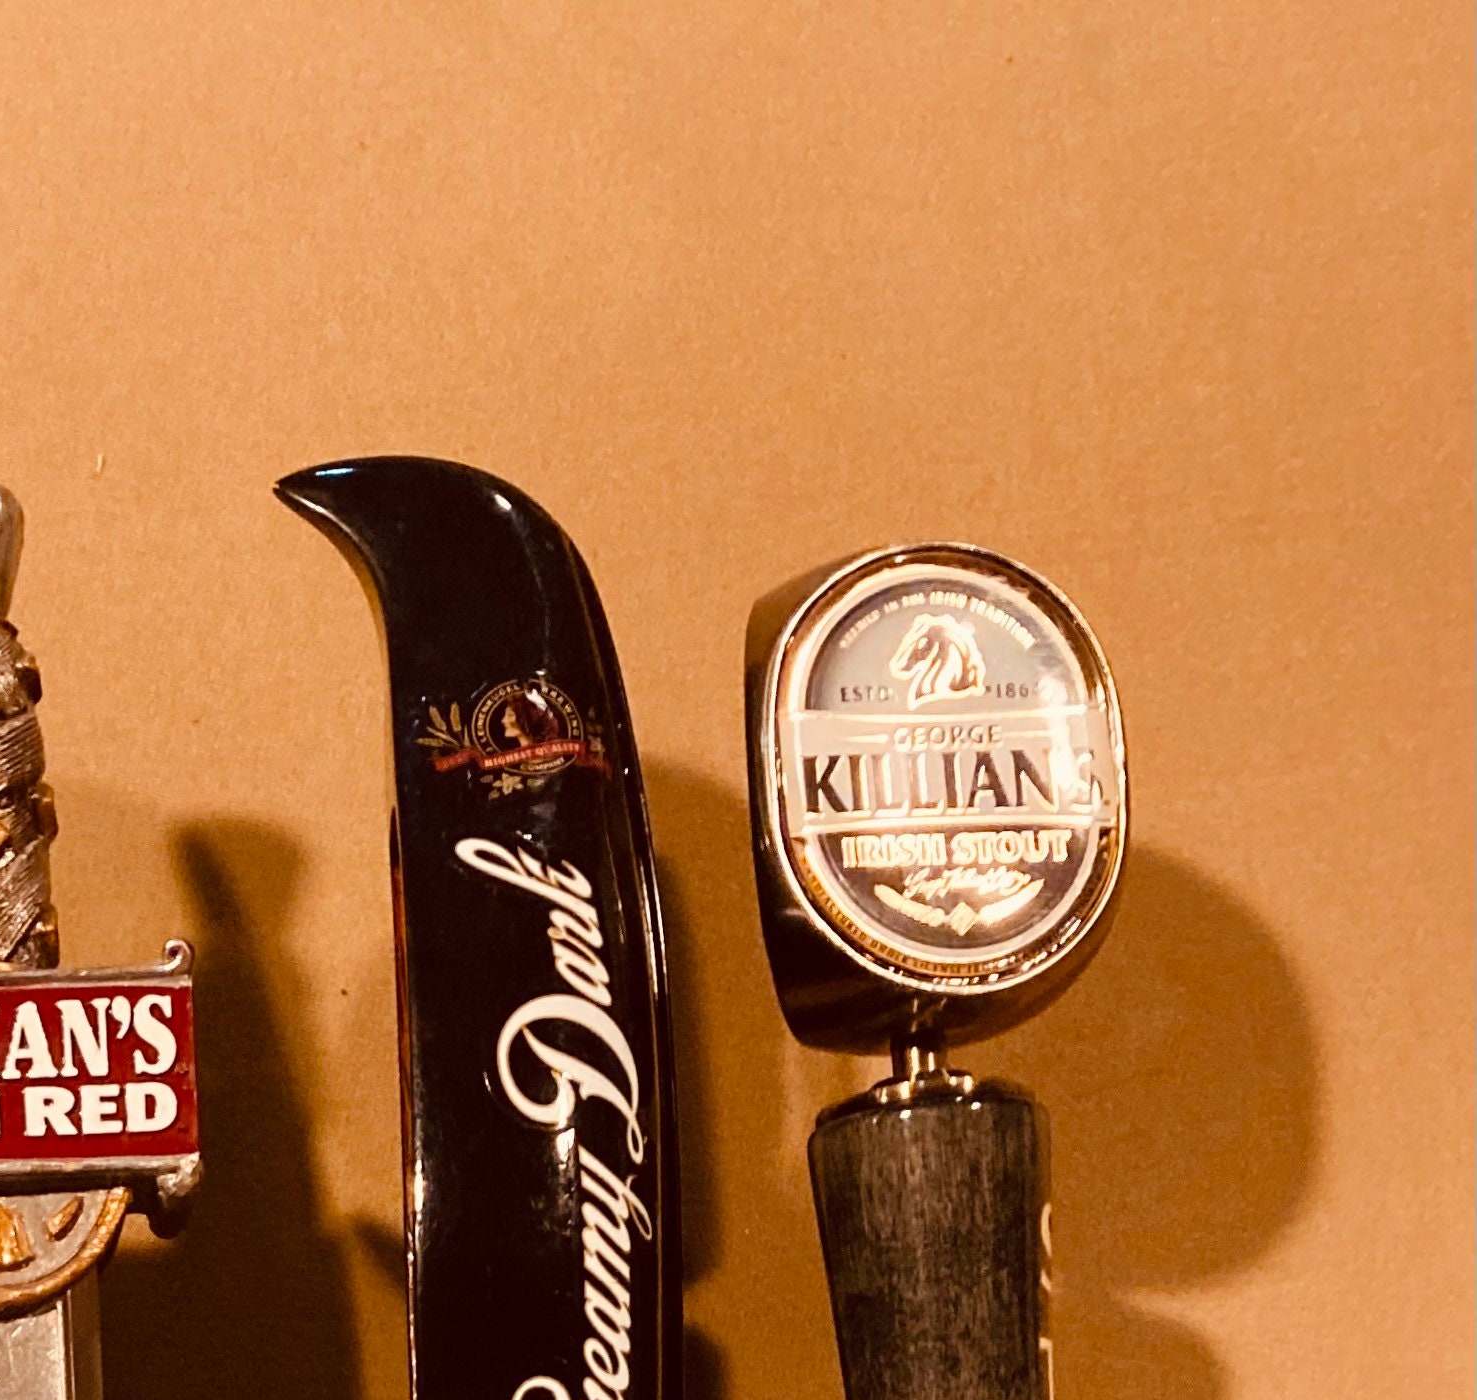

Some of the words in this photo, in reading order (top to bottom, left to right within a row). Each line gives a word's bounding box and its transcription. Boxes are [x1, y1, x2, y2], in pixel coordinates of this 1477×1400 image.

[893, 725, 1003, 750] GEORGE
[841, 832, 947, 868] IRISH
[951, 829, 1072, 866] STOUT
[455, 838, 643, 1165] Dark
[23, 1081, 178, 1137] RED
